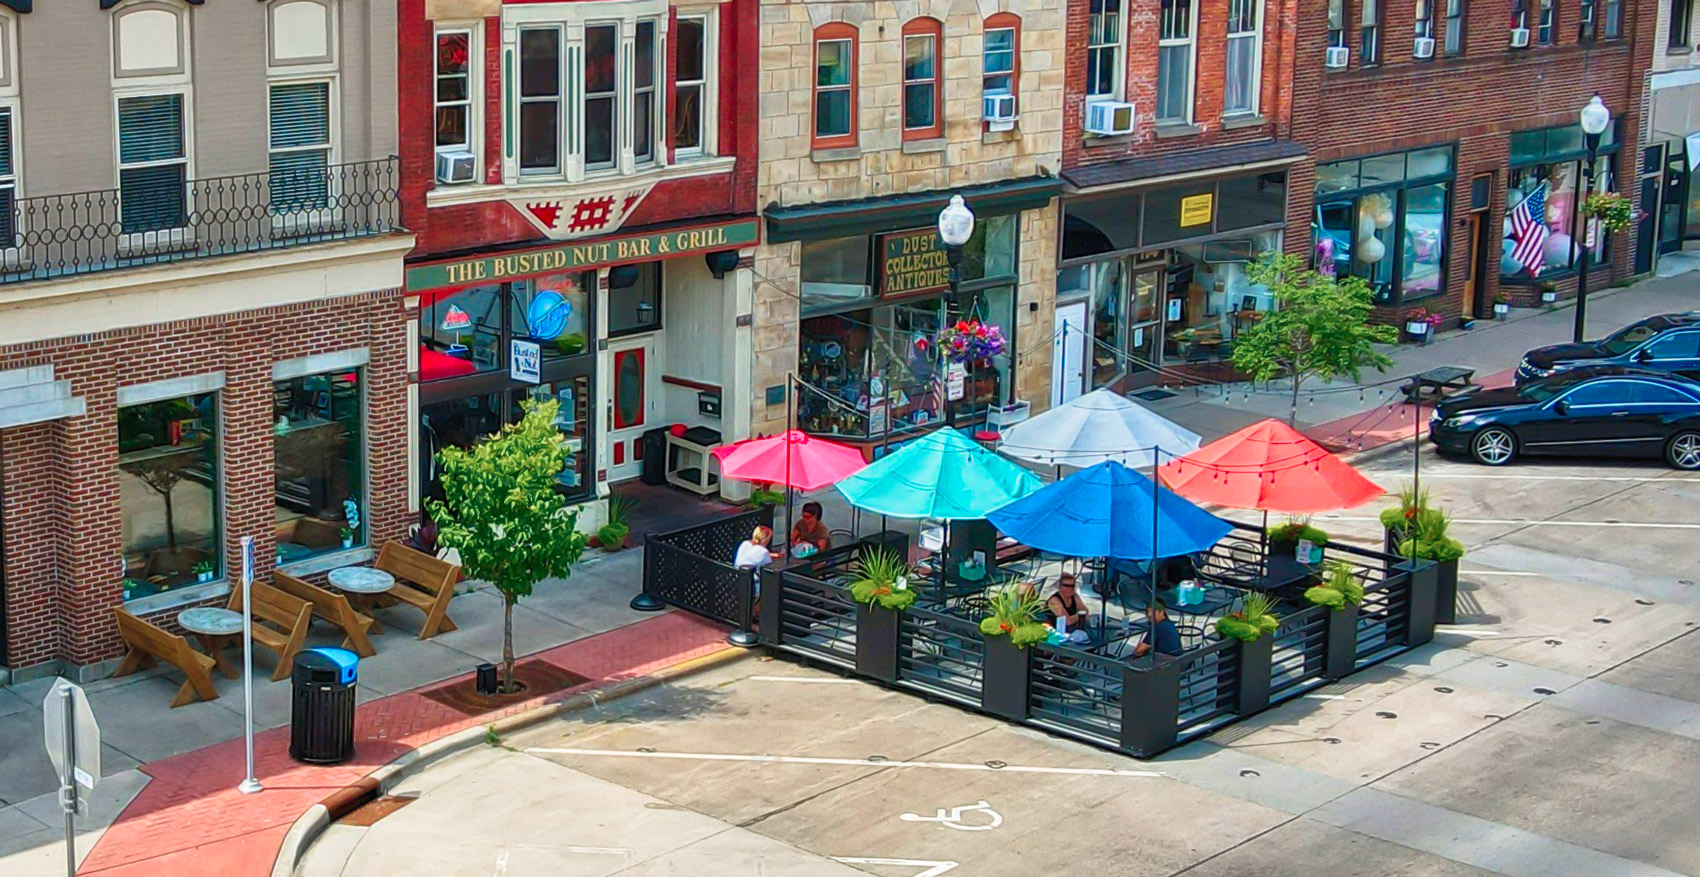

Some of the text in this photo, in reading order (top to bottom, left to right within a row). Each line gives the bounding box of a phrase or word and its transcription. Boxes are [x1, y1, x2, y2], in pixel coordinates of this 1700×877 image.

[446, 228, 728, 284] THE BUSTED NUT BAR & GRILL
[903, 233, 937, 255] DUST
[887, 267, 950, 291] ANTIQUES
